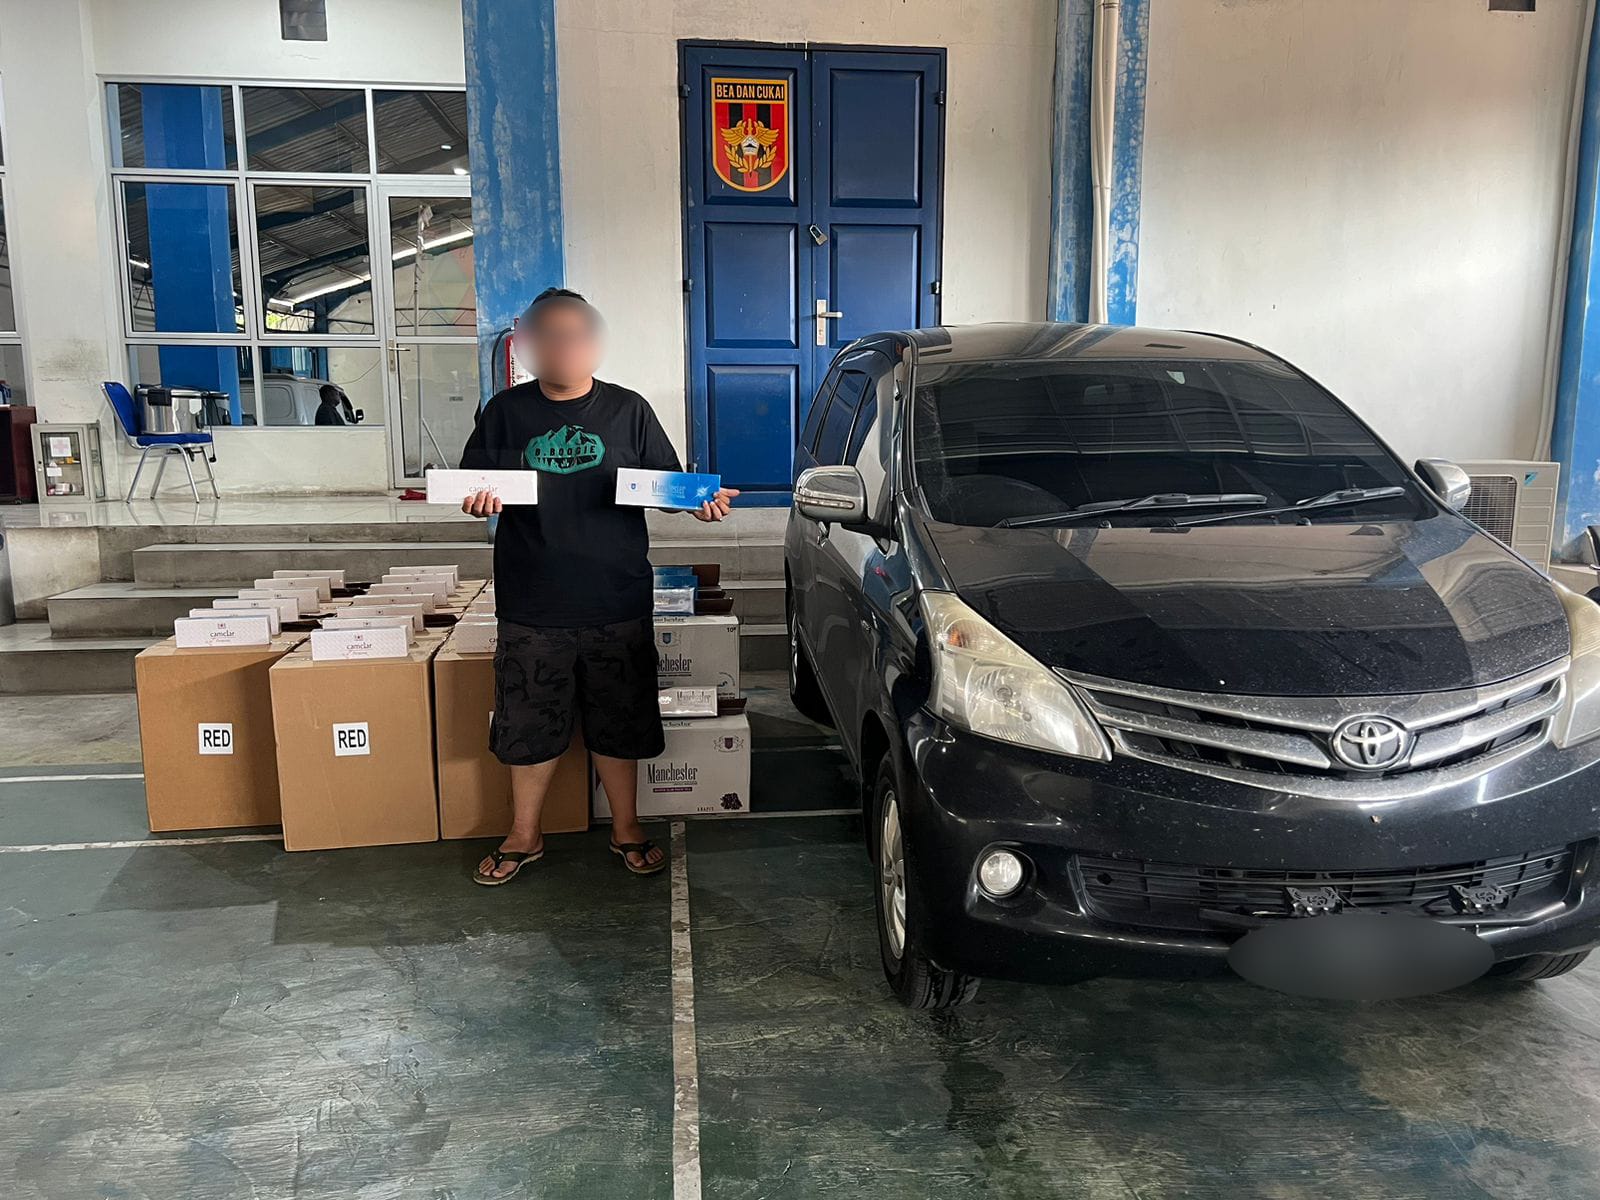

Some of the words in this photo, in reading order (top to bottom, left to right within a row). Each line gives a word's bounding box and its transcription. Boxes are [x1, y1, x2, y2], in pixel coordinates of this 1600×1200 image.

[716, 84, 735, 99] BEA
[736, 84, 755, 99] DAN
[757, 85, 784, 100] CUKAI
[203, 729, 231, 748] RED
[338, 729, 367, 749] RED
[647, 762, 698, 784] Manchester
